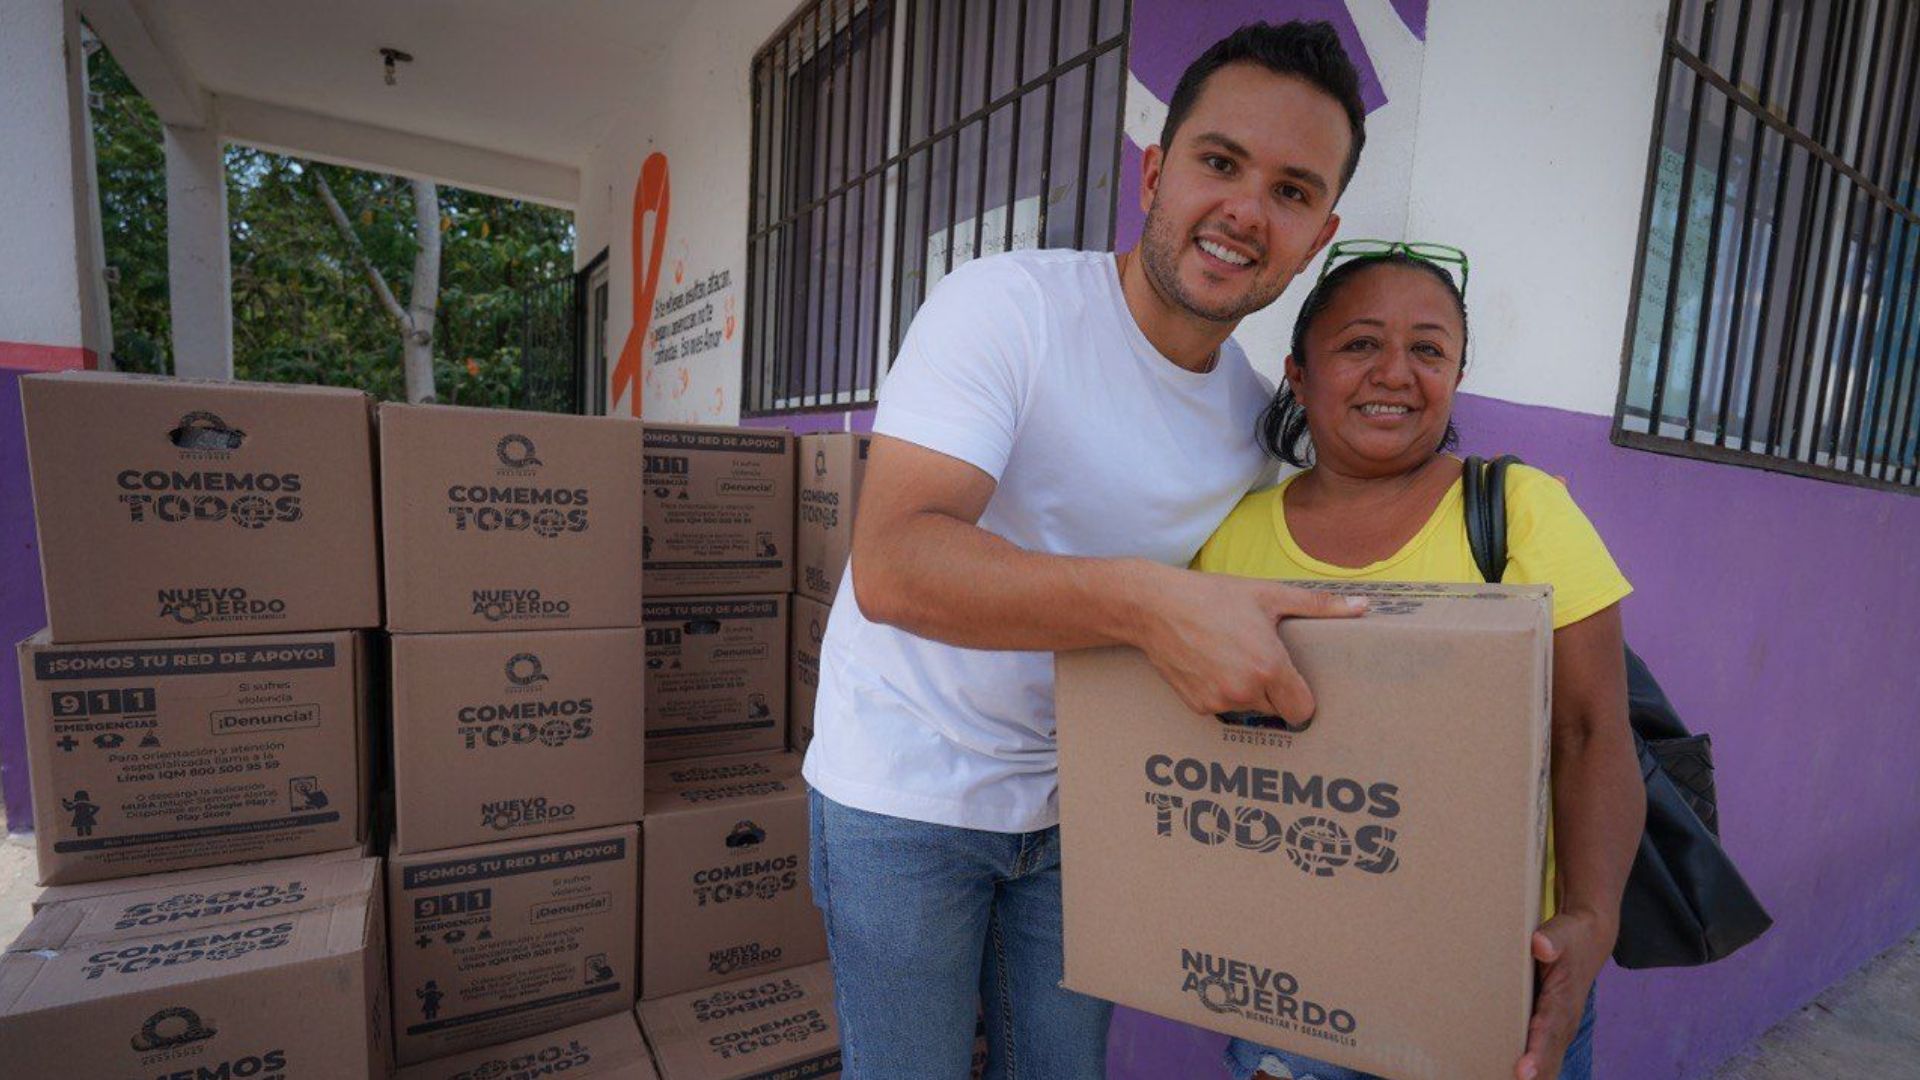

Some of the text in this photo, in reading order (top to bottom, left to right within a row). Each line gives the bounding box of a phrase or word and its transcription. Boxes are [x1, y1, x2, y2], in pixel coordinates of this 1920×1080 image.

[644, 432, 678, 443] OMOS
[681, 434, 696, 443] TU
[698, 435, 721, 445] RED
[116, 469, 302, 492] COMEMOS
[448, 485, 589, 506] COMEMOS
[158, 587, 247, 604] NUEVO
[472, 588, 541, 602] NUEVO
[675, 606, 689, 615] TU
[49, 648, 325, 674] ¡SOMOS TU RED DE APOYO!
[56, 690, 149, 715] 911
[458, 698, 593, 723] COMEMOS
[54, 719, 158, 733] EMERGENCIAS
[217, 710, 314, 730] ¡Denuncia!
[109, 752, 138, 764] Para
[159, 769, 187, 781] IQM
[1145, 753, 1400, 818] COMEMOS
[481, 797, 547, 816] NUEVO
[413, 844, 618, 884] ¡SOMOS TU RED DE APOYO!
[693, 855, 798, 886] COMEMOS
[419, 891, 485, 918] 911
[88, 922, 294, 966] COMEMOS
[1181, 948, 1299, 996] NUEVO
[709, 1009, 821, 1046] COMEMOS
